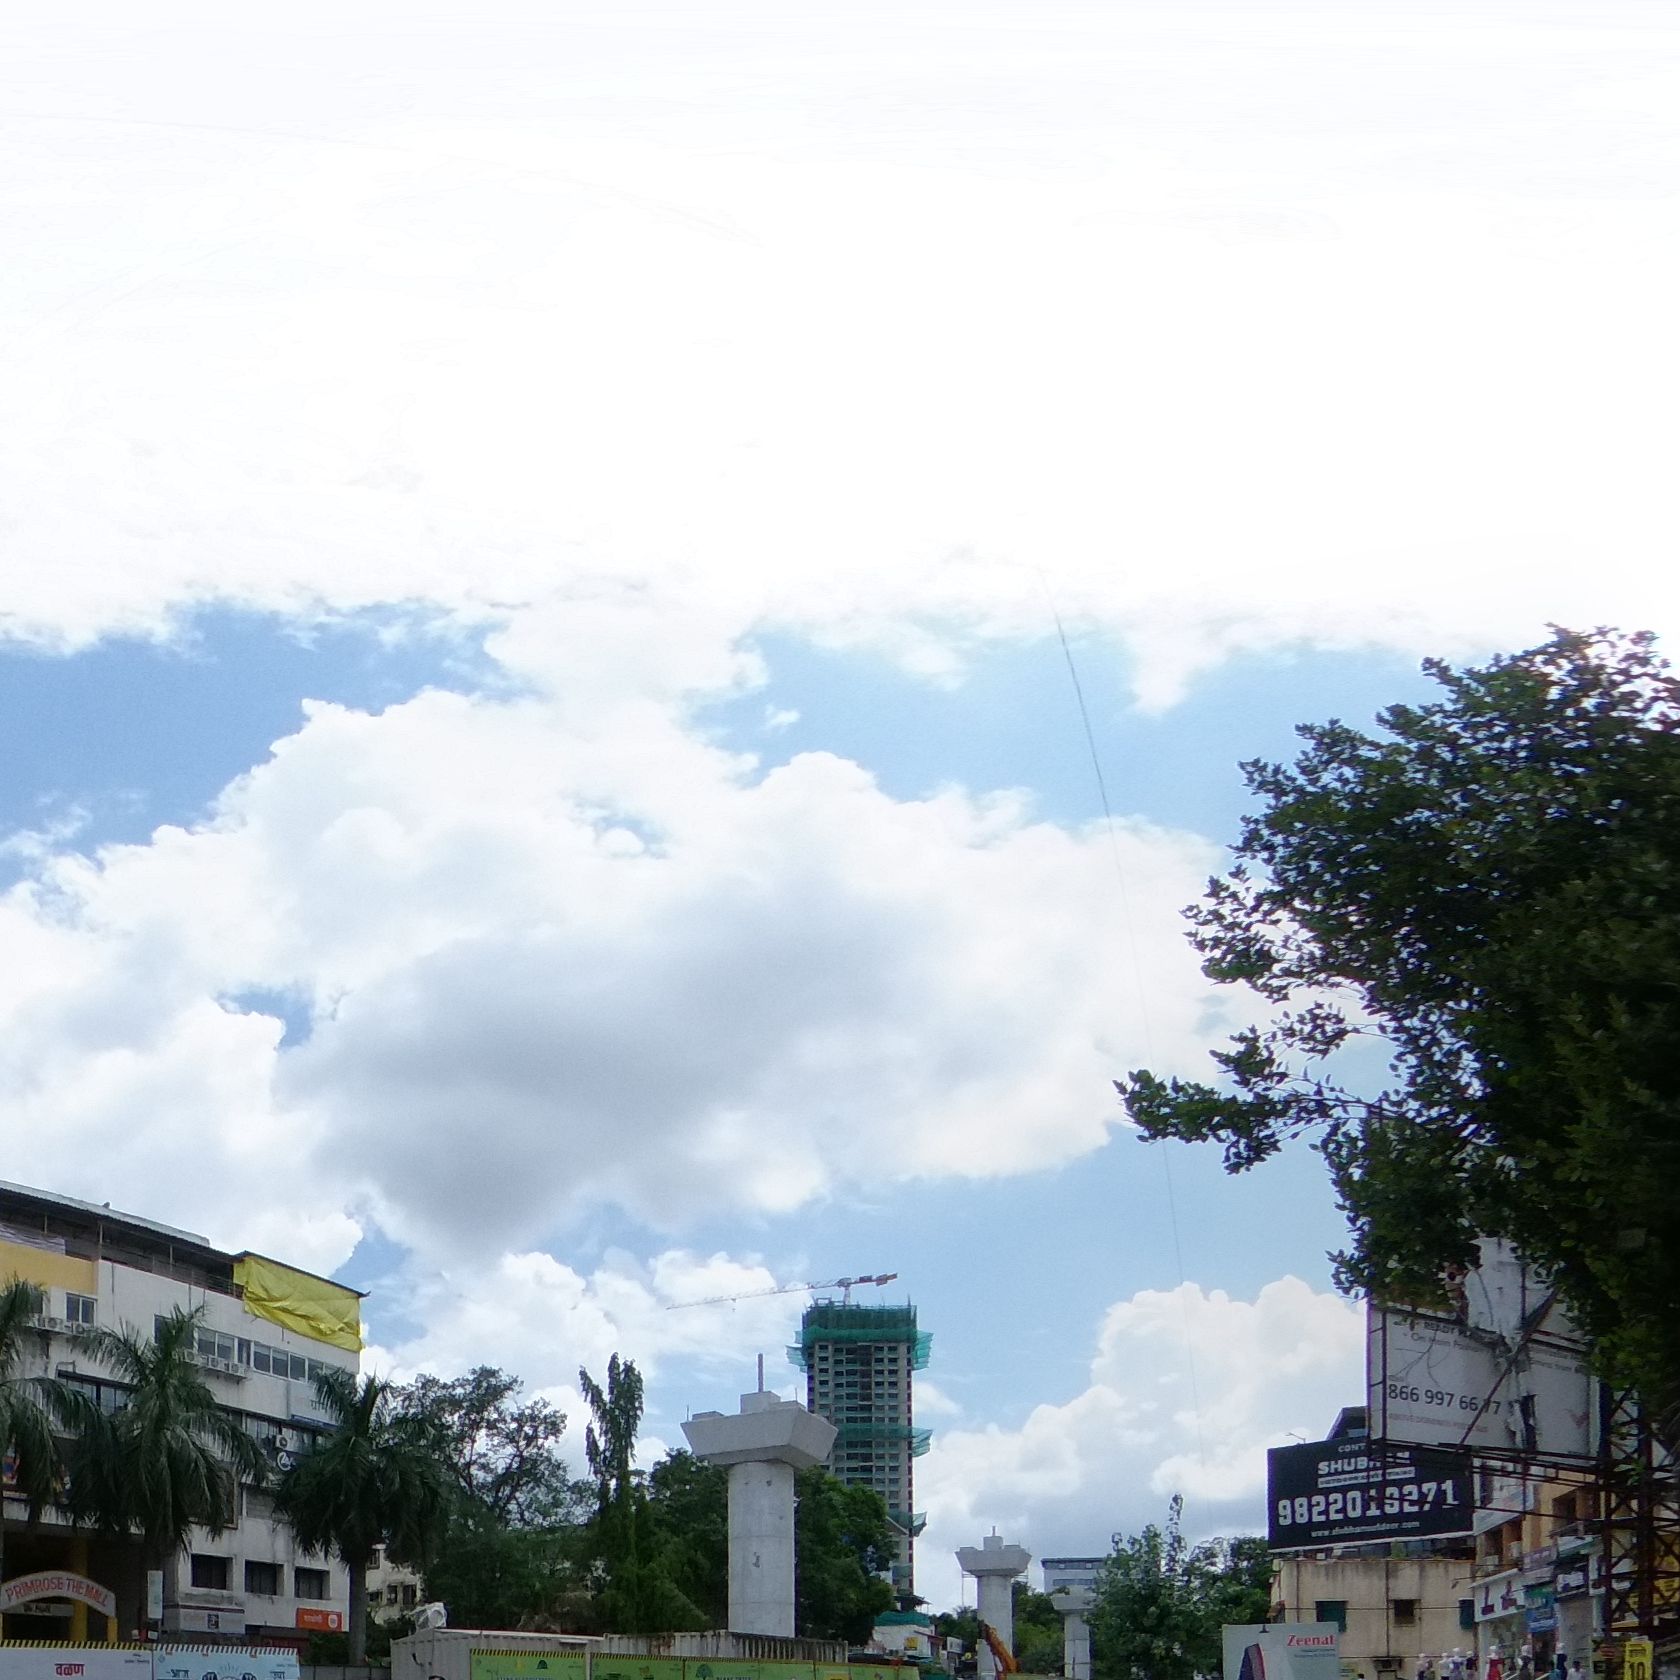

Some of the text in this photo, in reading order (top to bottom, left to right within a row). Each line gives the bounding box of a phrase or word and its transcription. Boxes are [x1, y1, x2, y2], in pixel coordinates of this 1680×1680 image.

[1389, 1384, 1420, 1402] 866
[1425, 1389, 1455, 1408] 997
[1460, 1395, 1479, 1412] 66
[5, 1576, 63, 1602] PRIMROSE
[1287, 1633, 1335, 1647] Zeenat
[55, 1662, 85, 1676] वळण
